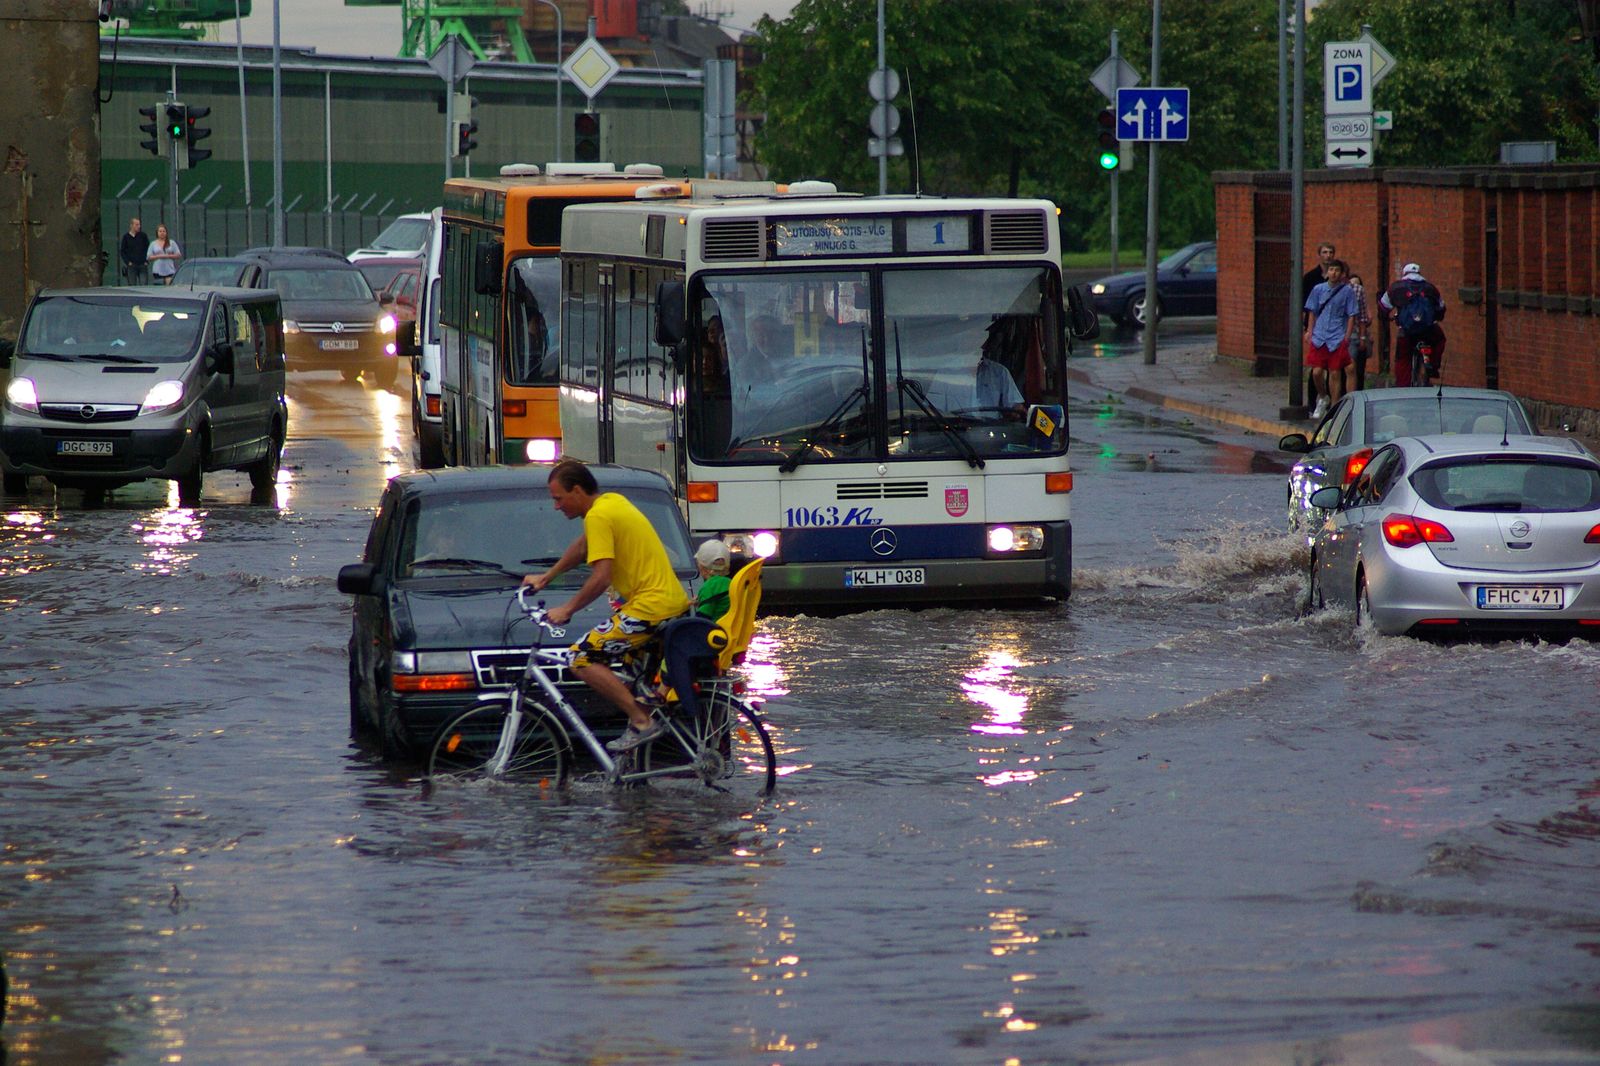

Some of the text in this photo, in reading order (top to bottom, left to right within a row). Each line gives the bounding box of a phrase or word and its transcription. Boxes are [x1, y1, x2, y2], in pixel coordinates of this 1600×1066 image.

[1333, 49, 1363, 59] ZONA
[1337, 66, 1360, 99] P
[1341, 124, 1351, 132] 20
[1353, 123, 1366, 133] 50
[834, 226, 861, 238] OTIS
[932, 221, 945, 245] 1
[814, 240, 846, 252] MINIJOS
[63, 442, 112, 453] DGC 975
[784, 506, 840, 528] 1063
[854, 571, 886, 584] KLH
[895, 570, 922, 584] 038
[1487, 589, 1559, 604] FHC 471
